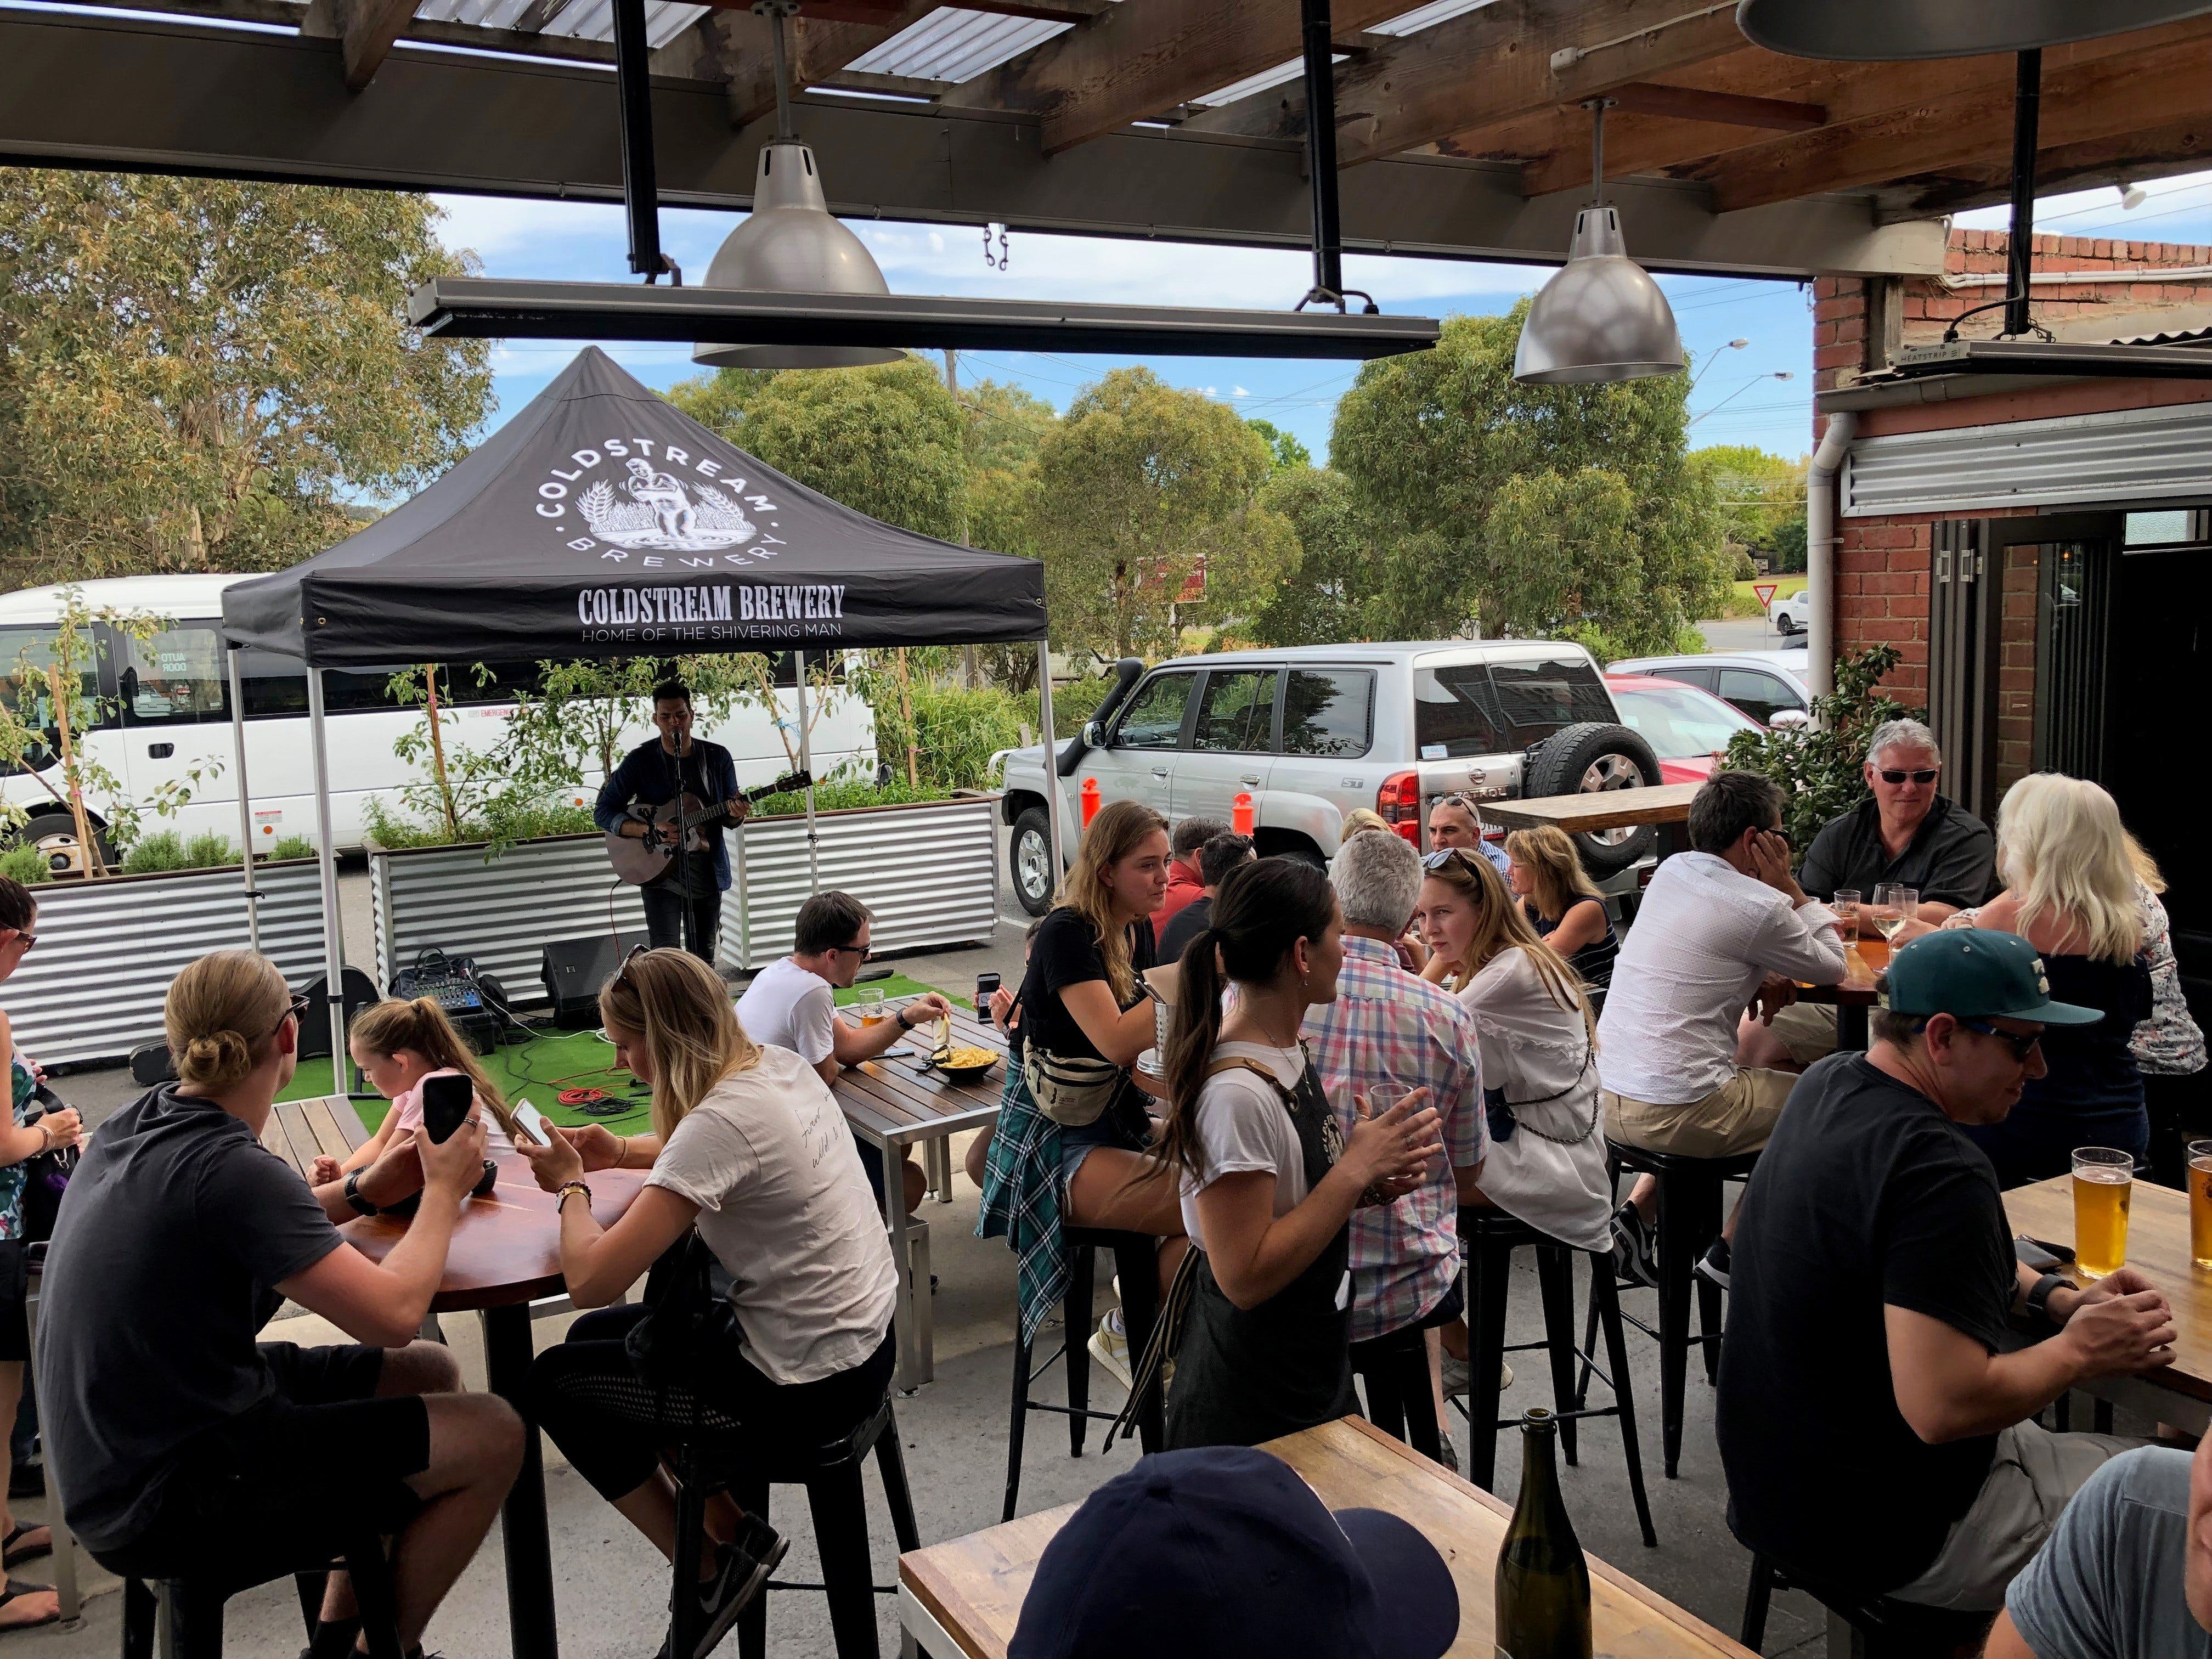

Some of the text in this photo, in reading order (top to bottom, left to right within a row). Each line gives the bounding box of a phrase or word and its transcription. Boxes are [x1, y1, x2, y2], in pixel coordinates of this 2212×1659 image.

[1901, 352, 1946, 362] HEATSTRIP
[535, 438, 778, 517] COLDSTREAM
[566, 533, 787, 567] BREWERY
[578, 585, 845, 625] COLDSTREAM BREWERY
[582, 623, 841, 642] HOME OF THE SHIVERING MAN
